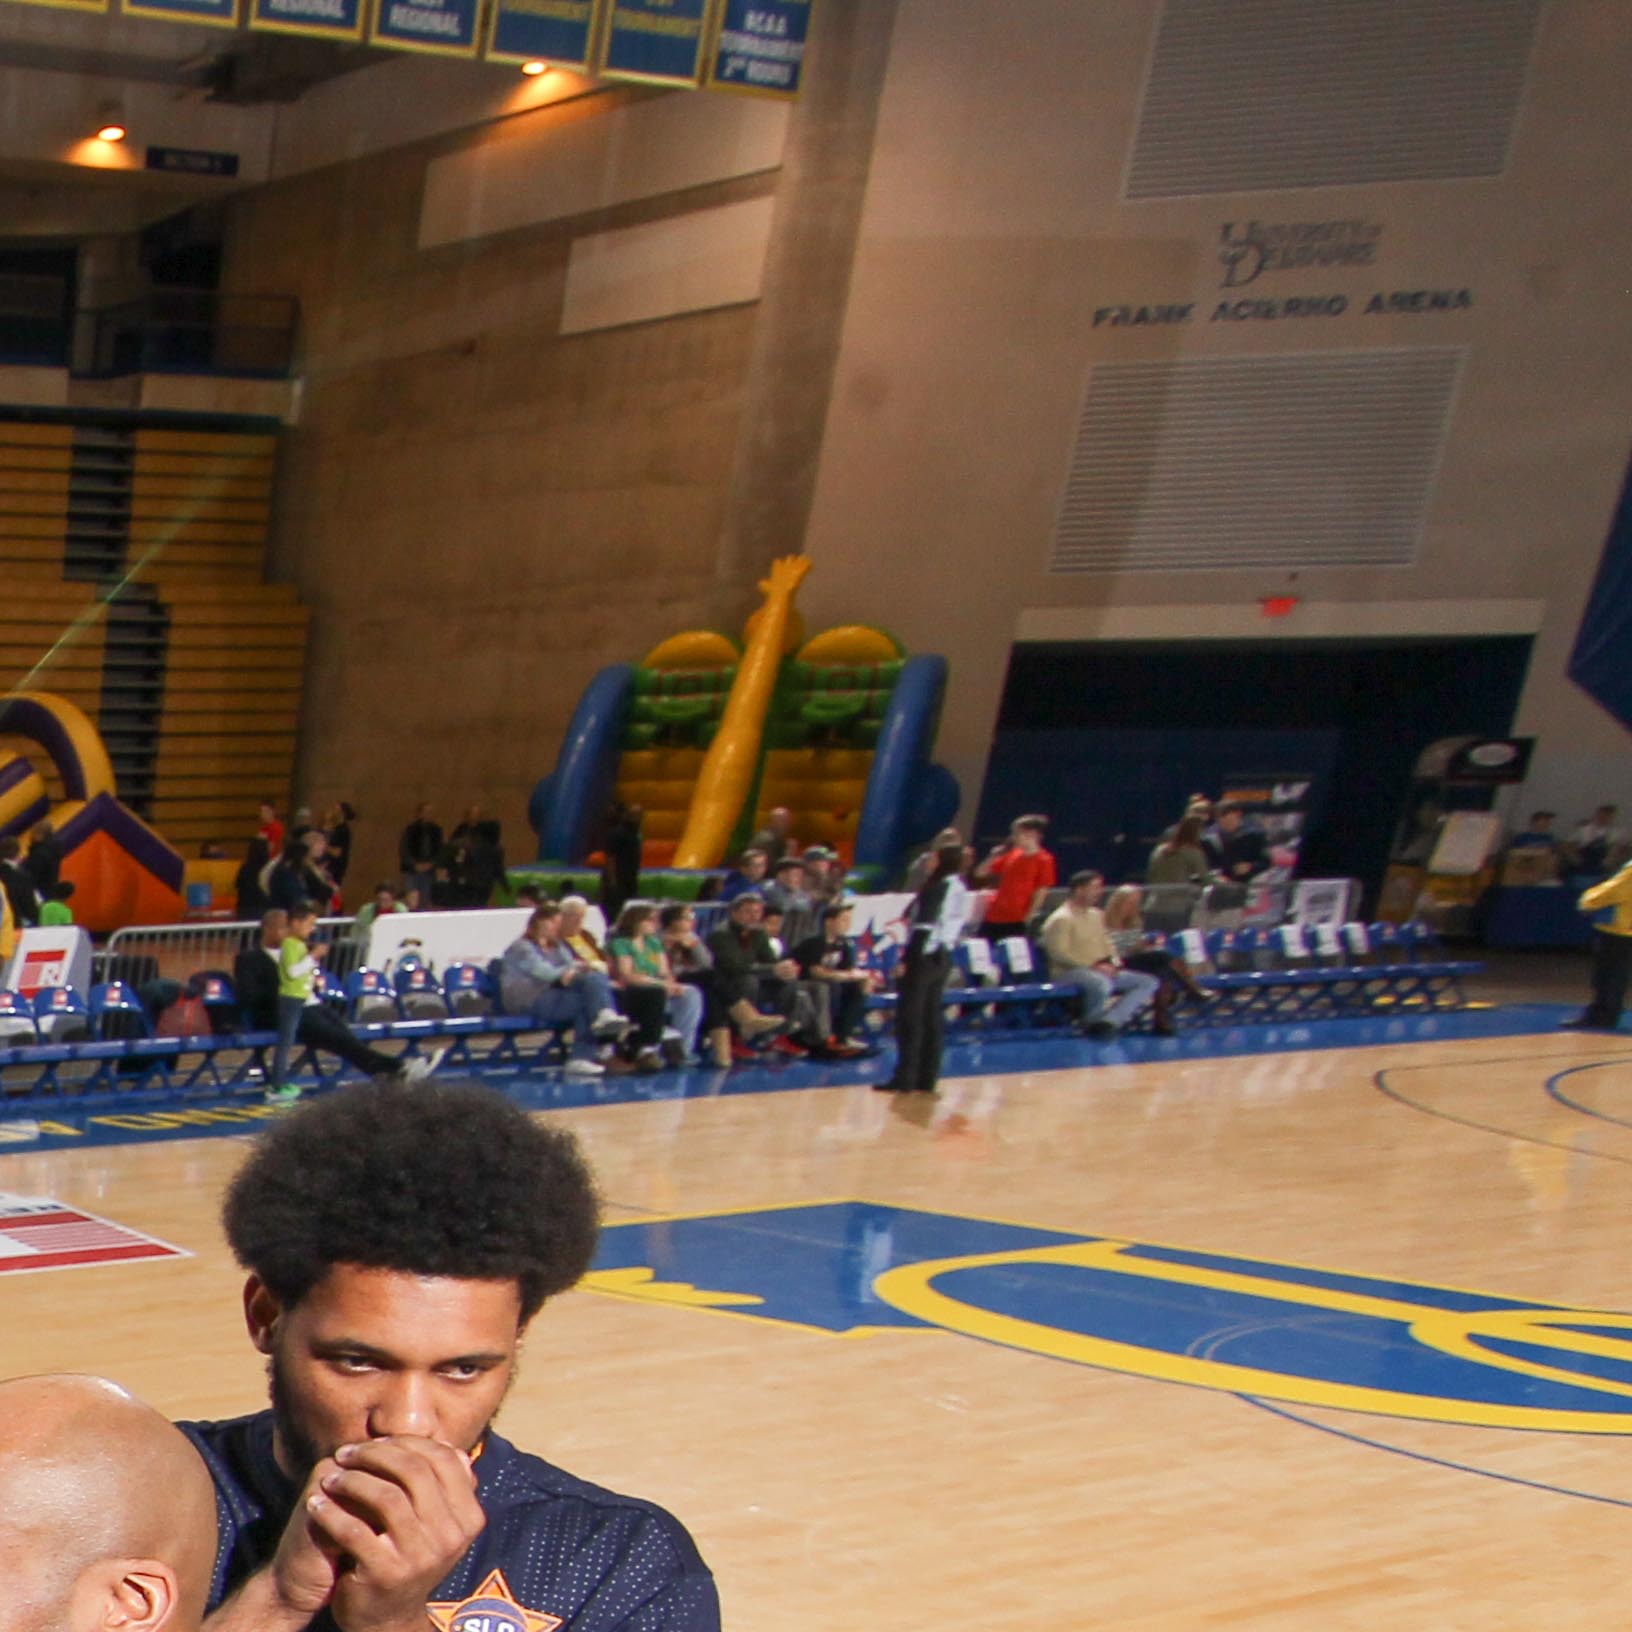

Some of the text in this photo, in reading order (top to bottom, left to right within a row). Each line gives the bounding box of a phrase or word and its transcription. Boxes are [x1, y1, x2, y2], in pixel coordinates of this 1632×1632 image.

[1092, 288, 1472, 328] FRANK ACIERNO ARENA
